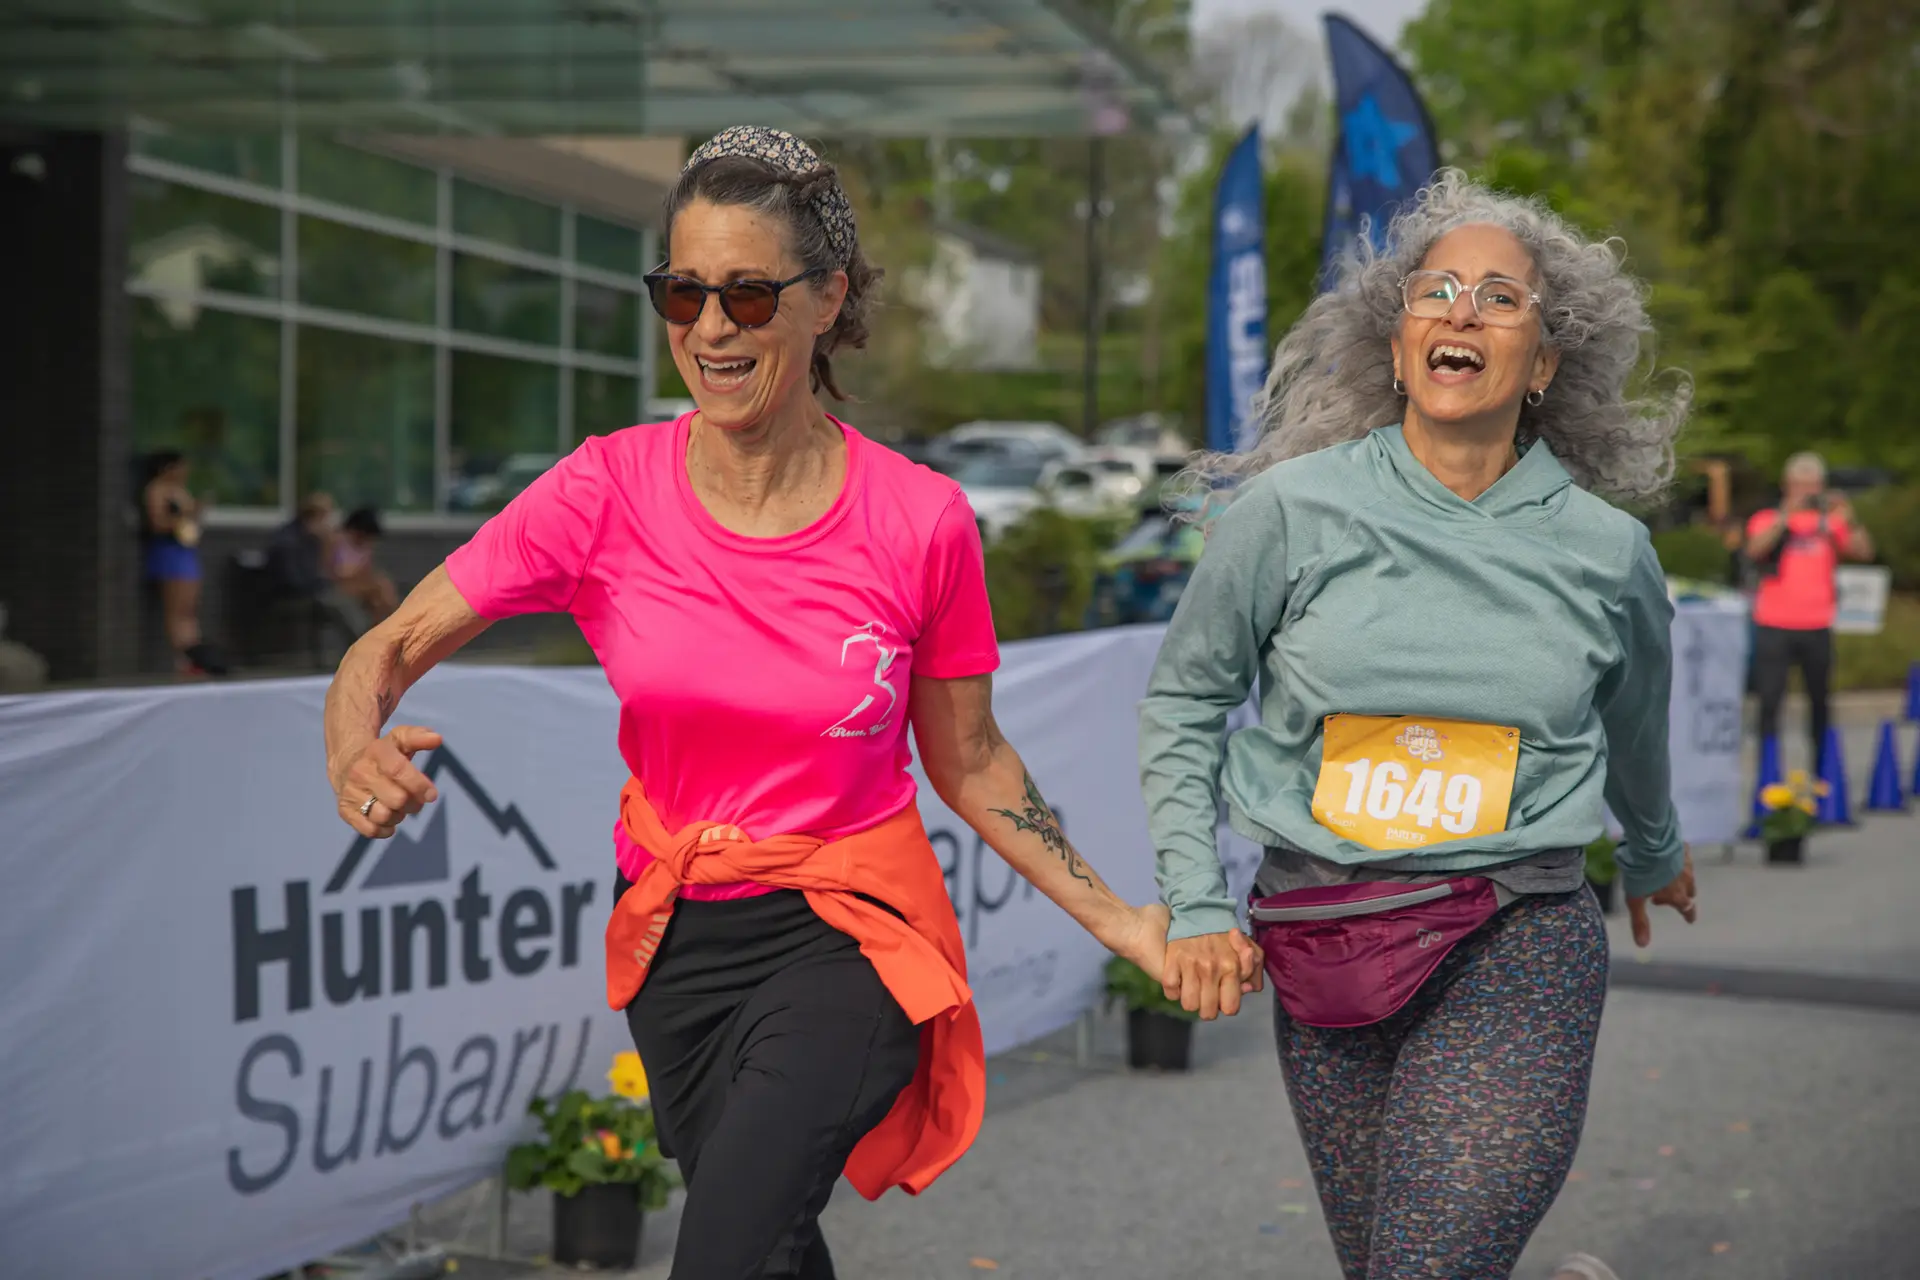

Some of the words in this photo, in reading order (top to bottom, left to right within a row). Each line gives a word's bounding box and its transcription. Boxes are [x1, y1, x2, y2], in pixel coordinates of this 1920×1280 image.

[1404, 724, 1437, 737] she
[1344, 758, 1481, 834] 1649
[232, 865, 595, 1022] Hunter
[227, 1013, 592, 1194] Subaru
